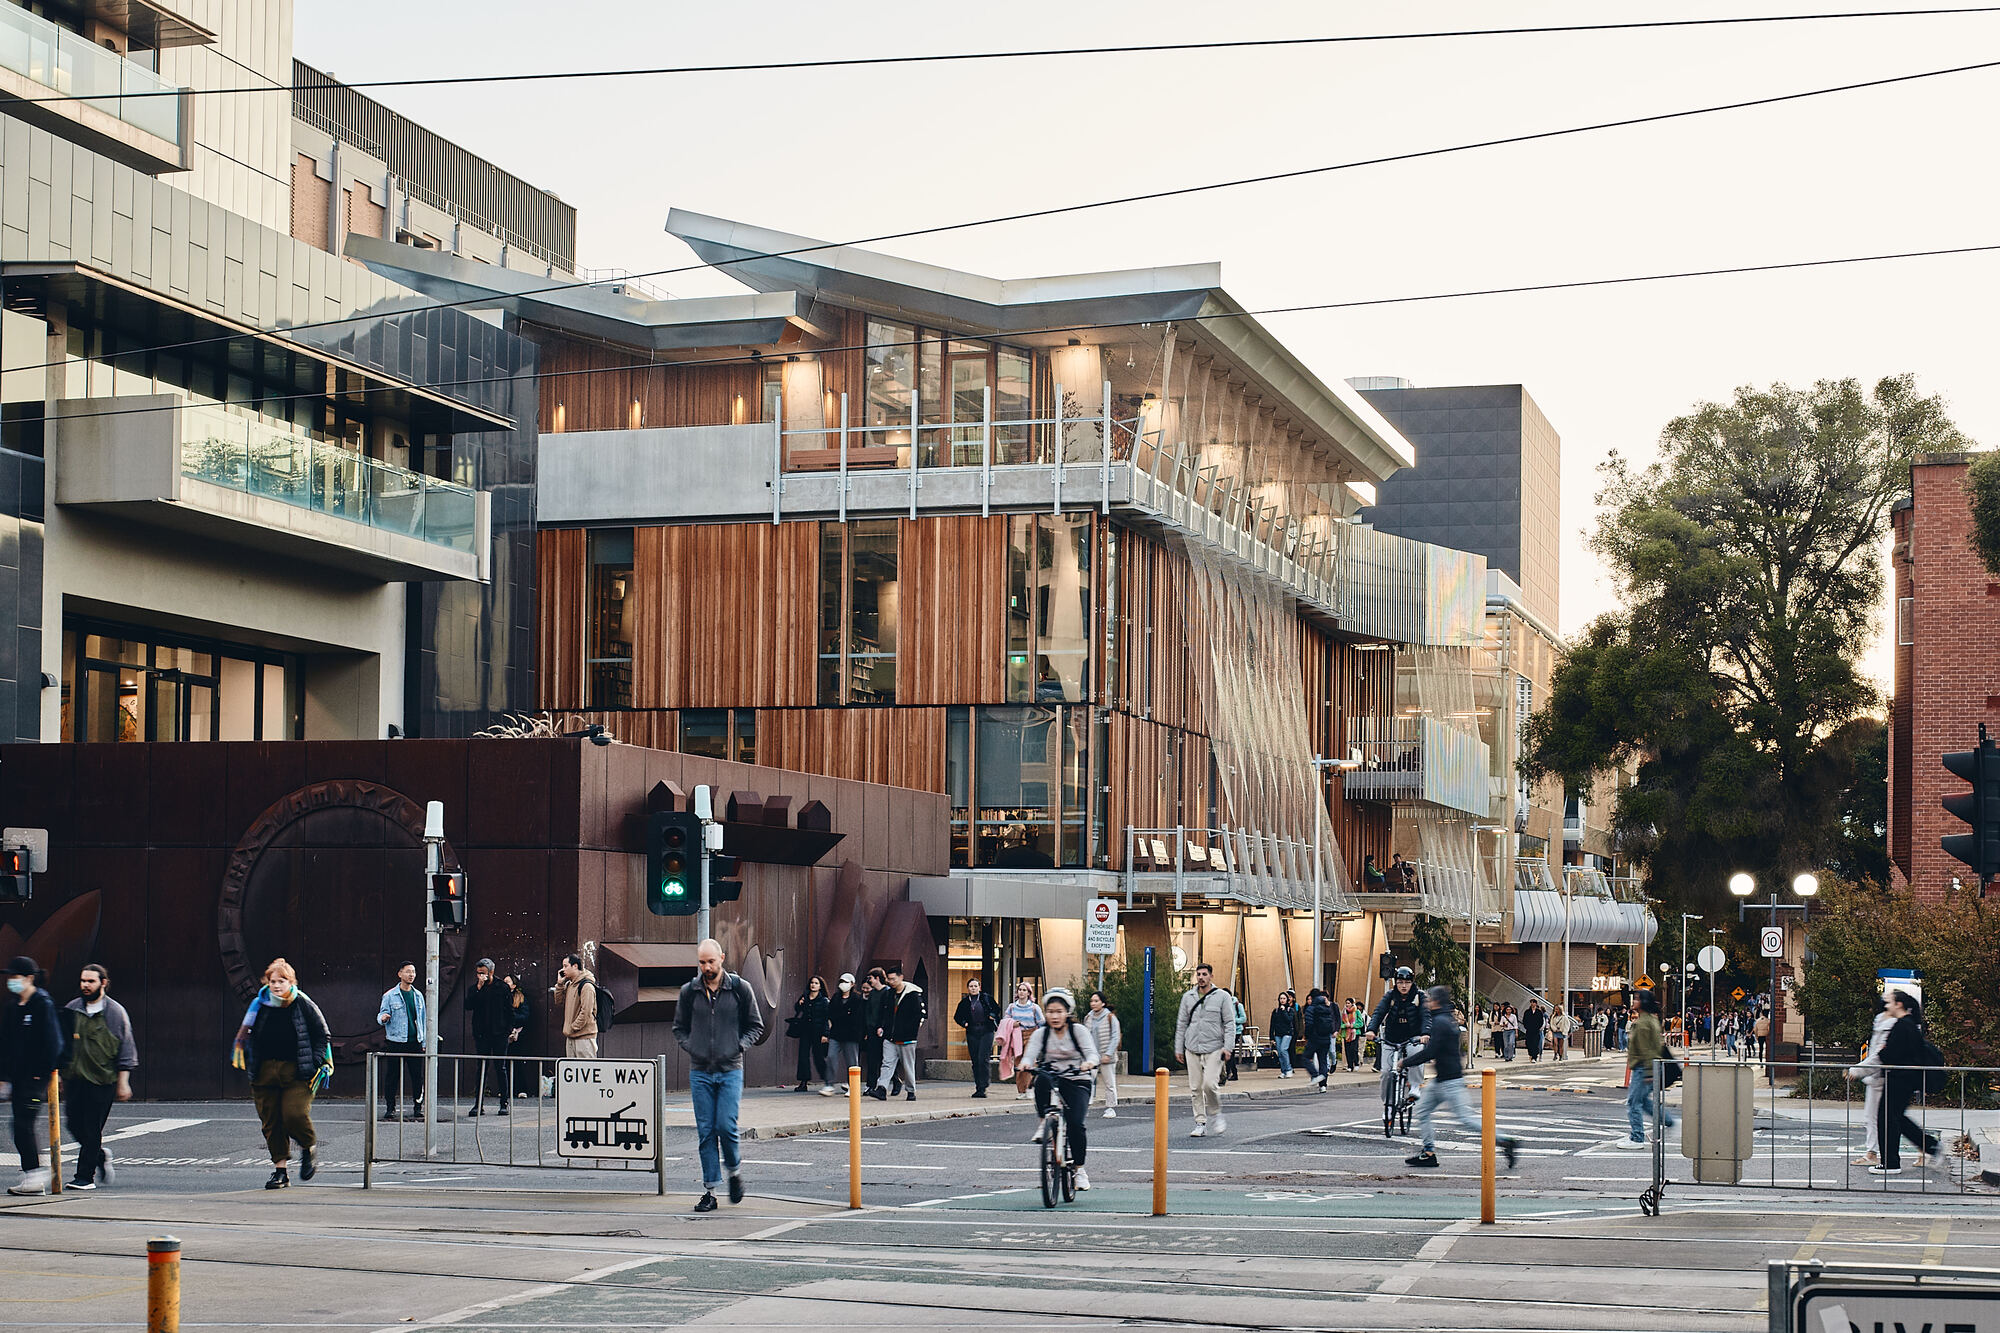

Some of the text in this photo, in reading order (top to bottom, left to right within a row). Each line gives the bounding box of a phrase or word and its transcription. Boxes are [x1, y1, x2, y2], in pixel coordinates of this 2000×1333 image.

[1767, 936, 1777, 947] 10
[564, 1068, 648, 1084] GIVE WAY
[599, 1089, 614, 1098] TO
